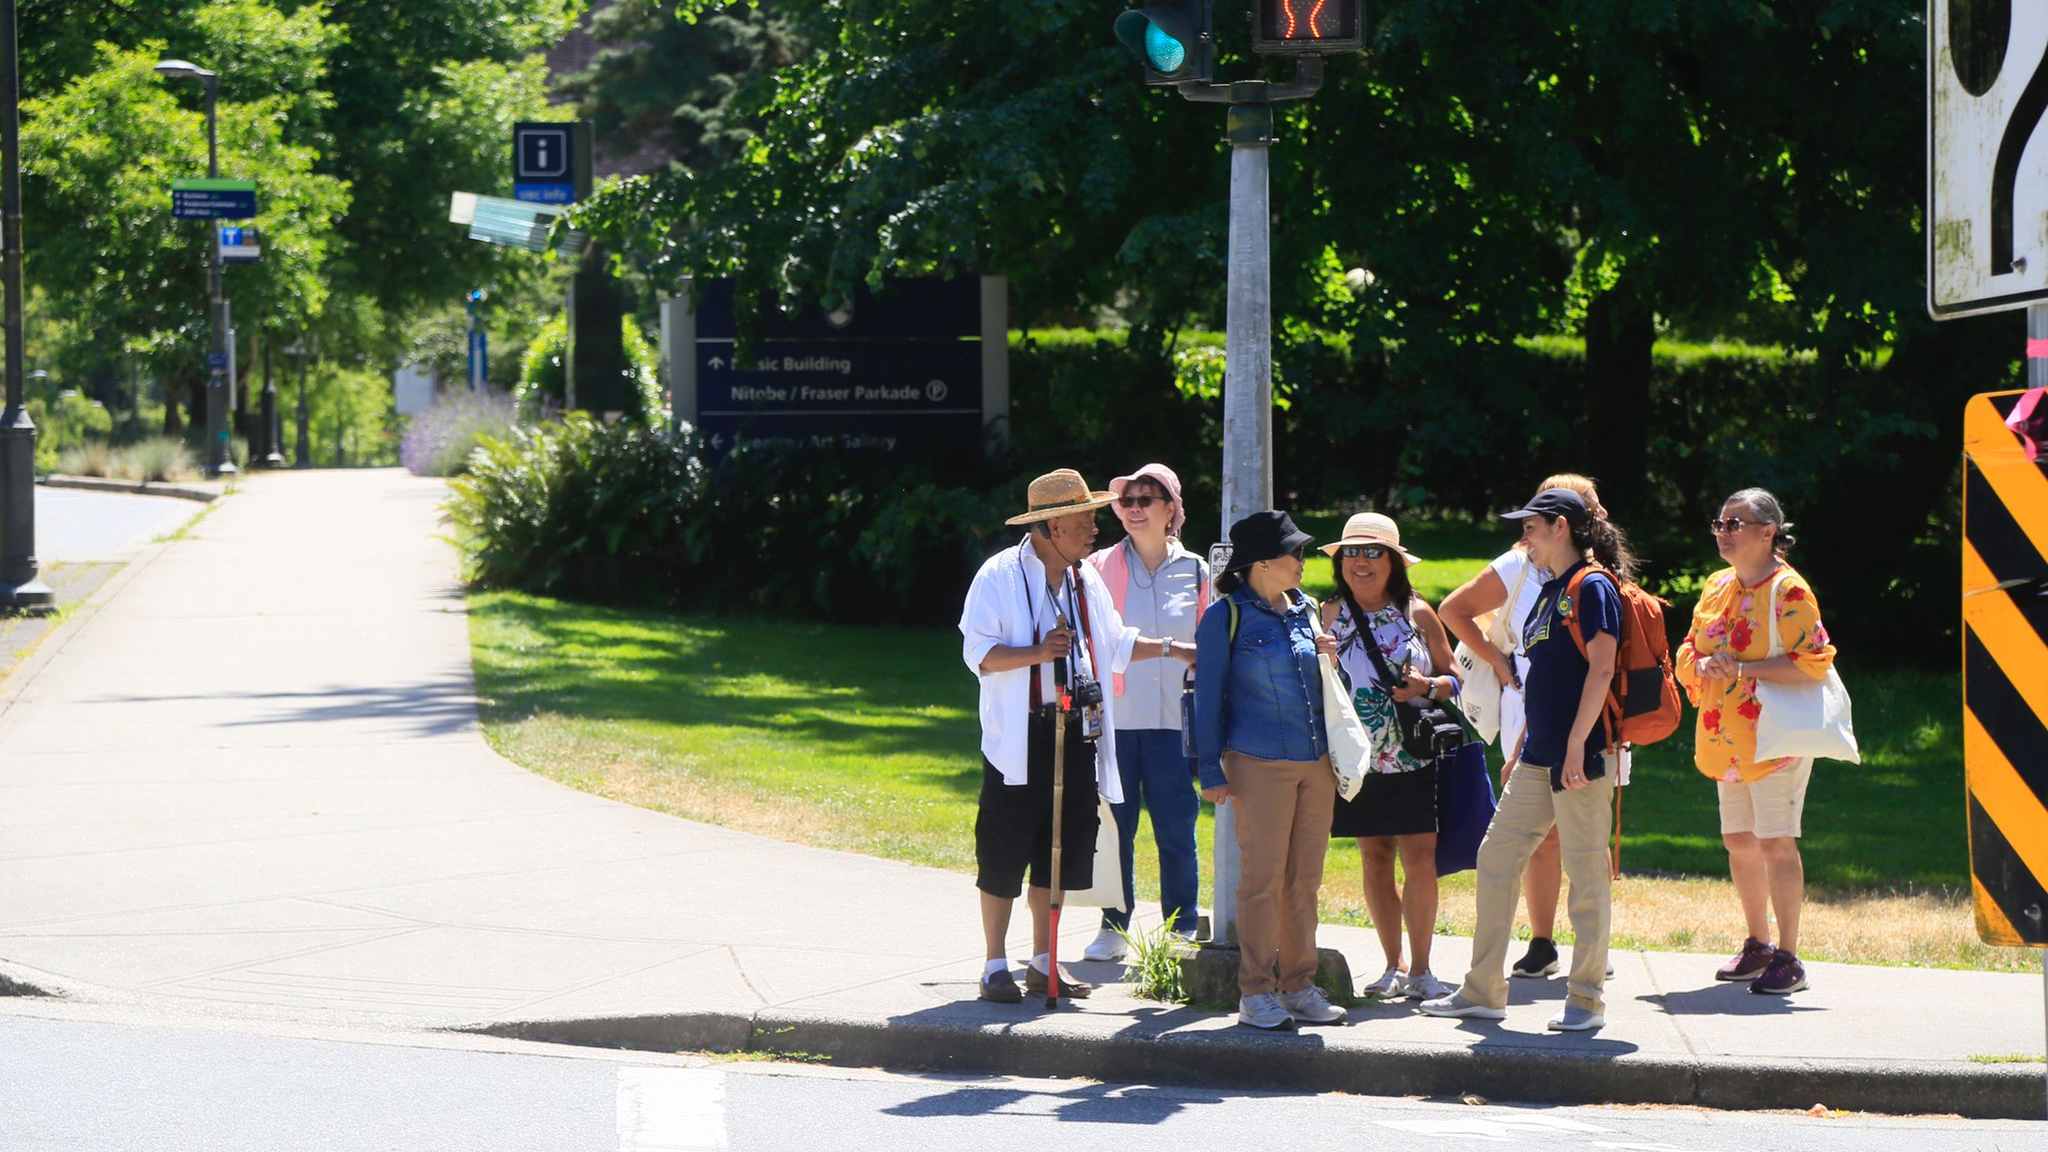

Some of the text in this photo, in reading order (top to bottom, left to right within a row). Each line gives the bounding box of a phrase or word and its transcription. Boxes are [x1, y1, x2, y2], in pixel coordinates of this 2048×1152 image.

[731, 356, 852, 375] sic Building
[731, 385, 787, 401] Nitobe
[801, 386, 849, 401] Fraser
[855, 385, 920, 400] Parkade
